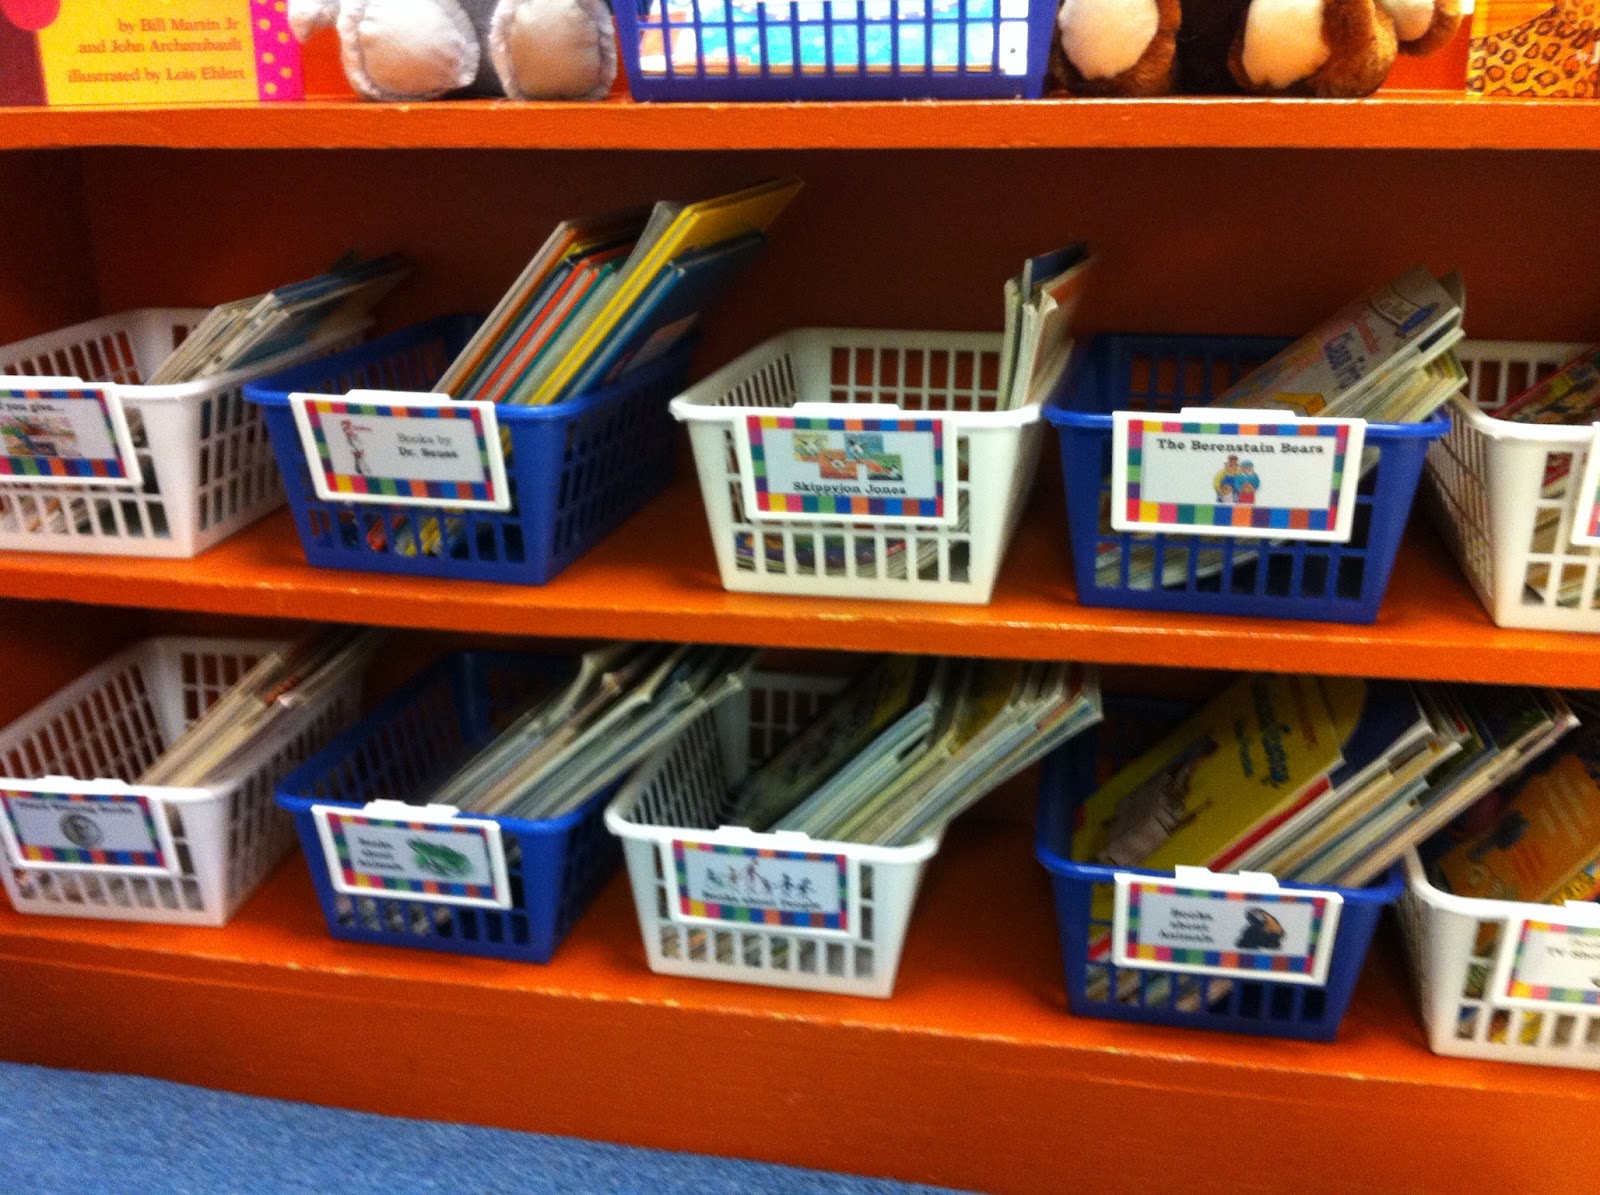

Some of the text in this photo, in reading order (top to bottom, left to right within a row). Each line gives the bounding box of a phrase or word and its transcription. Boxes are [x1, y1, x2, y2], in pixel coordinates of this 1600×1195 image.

[117, 17, 241, 33] by Bill Martin Jr
[78, 38, 243, 53] and John Archambault
[67, 67, 245, 83] illustrated by Lois Ehlert
[397, 433, 434, 444] Books
[1156, 438, 1325, 455] The Berenstain Bears
[398, 447, 416, 457] Dr.
[792, 480, 908, 496] Skippyjon Jones
